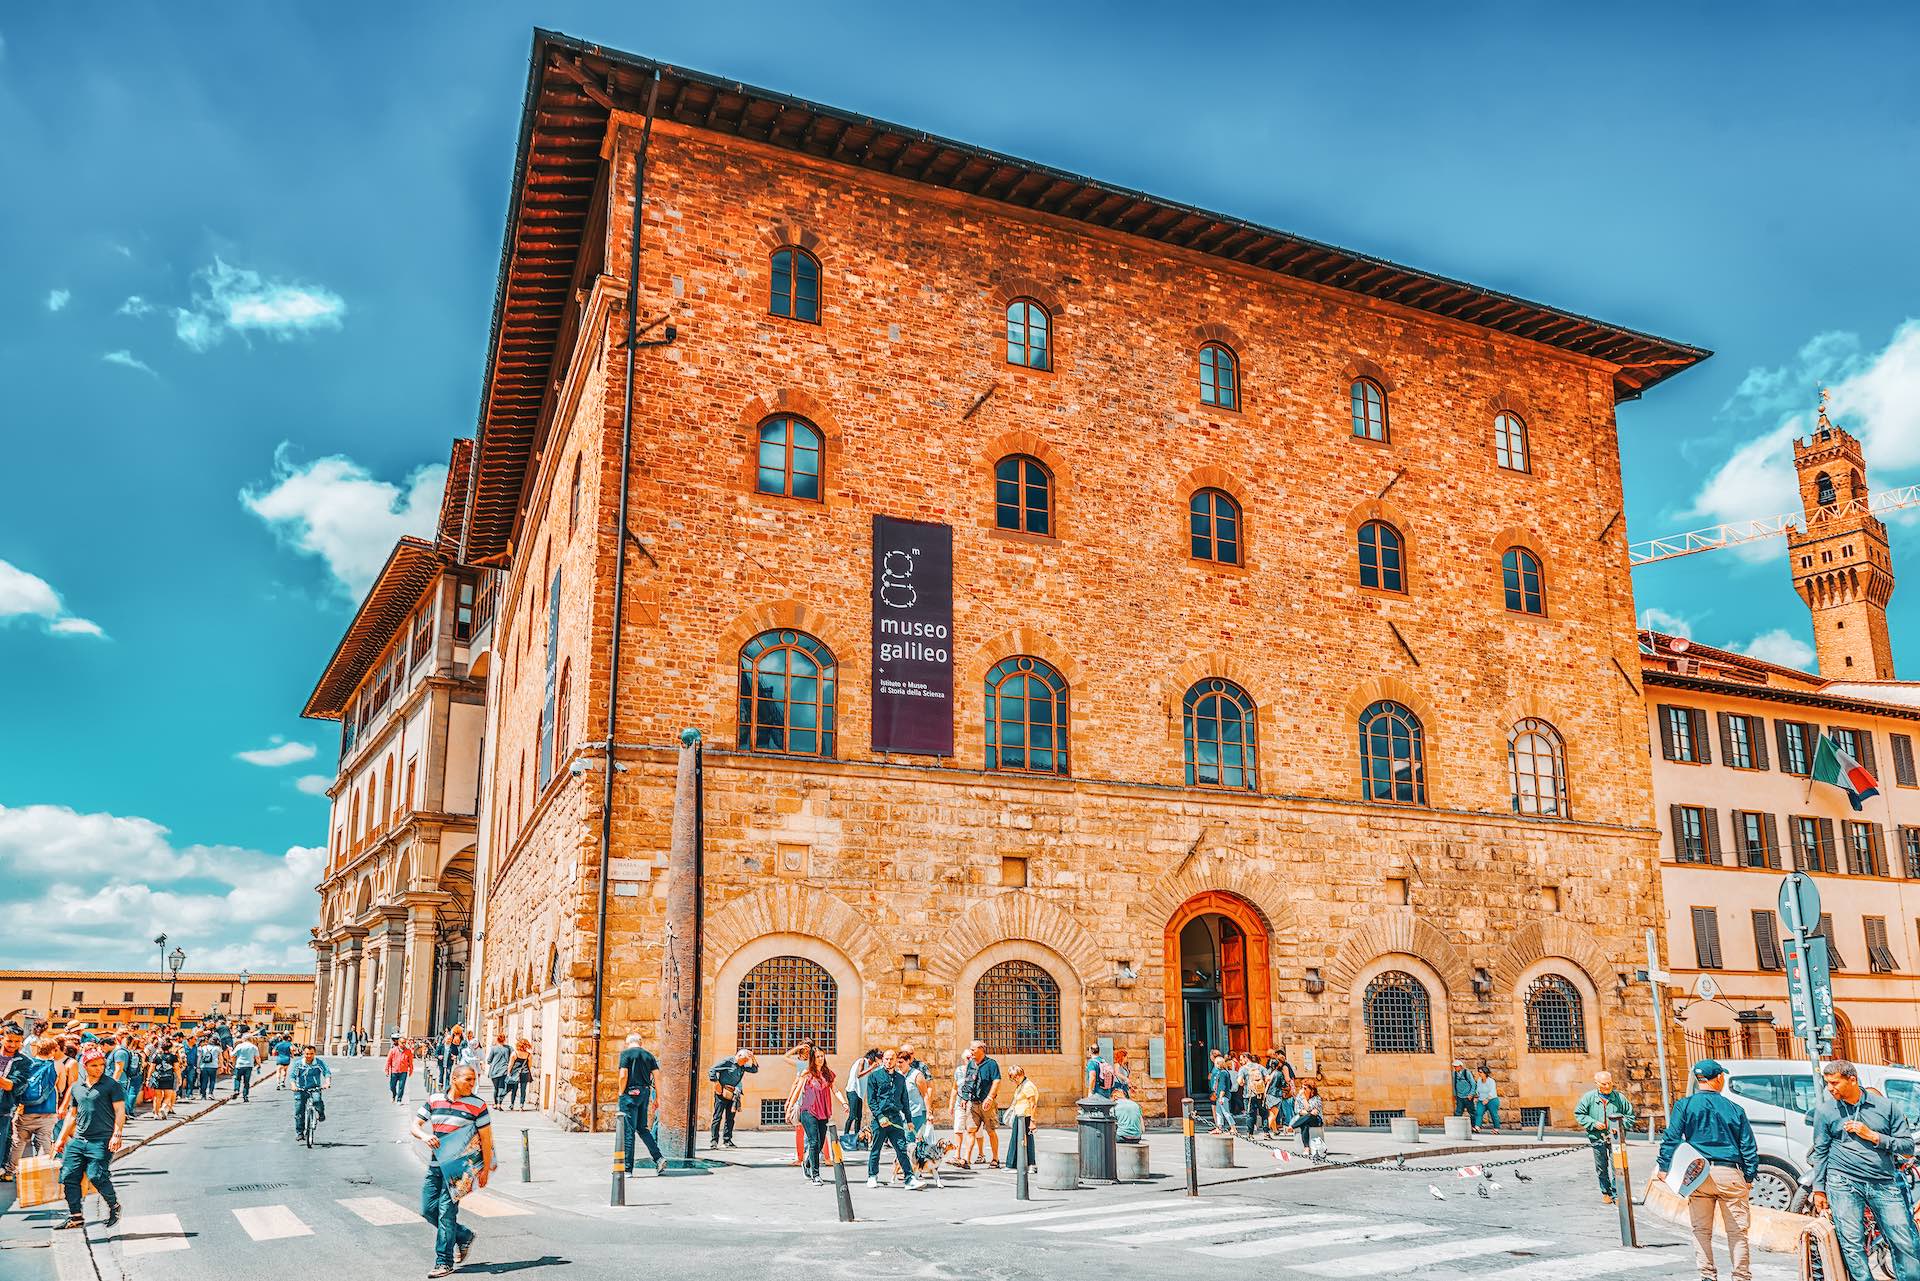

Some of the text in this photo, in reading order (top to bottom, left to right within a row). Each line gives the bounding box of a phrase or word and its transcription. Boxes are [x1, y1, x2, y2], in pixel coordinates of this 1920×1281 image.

[880, 618, 948, 639] museo
[880, 641, 948, 663] galileo
[880, 679, 902, 688] Istituto
[907, 681, 928, 690] Museo
[880, 686, 945, 699] di Storia della Scienza
